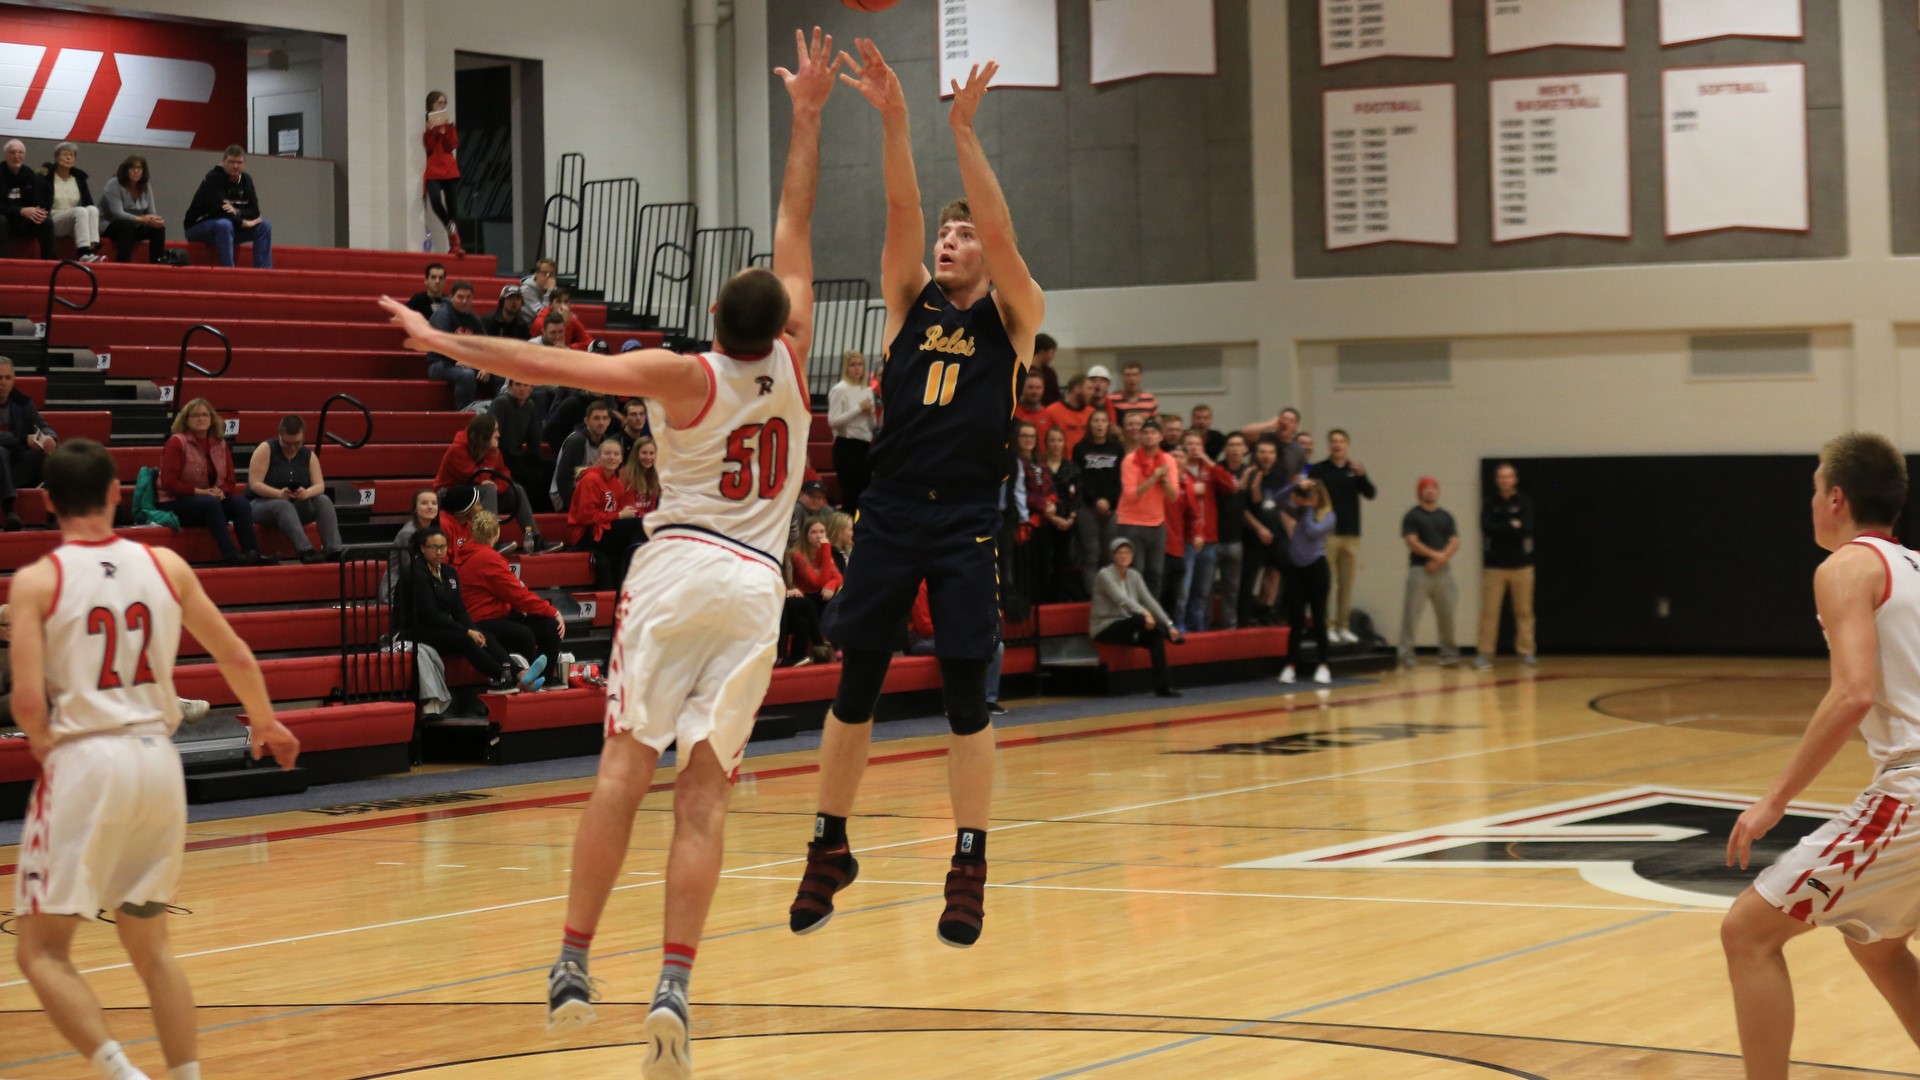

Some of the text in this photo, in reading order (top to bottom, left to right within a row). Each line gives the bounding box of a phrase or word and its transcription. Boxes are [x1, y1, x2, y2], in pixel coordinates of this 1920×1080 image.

[1698, 83, 1769, 96] SOFTBALL
[1354, 102, 1423, 113] FOOTBALL
[1514, 98, 1602, 112] BASKETBALL
[923, 360, 960, 406] 11
[719, 417, 789, 501] 50
[86, 601, 157, 691] 22
